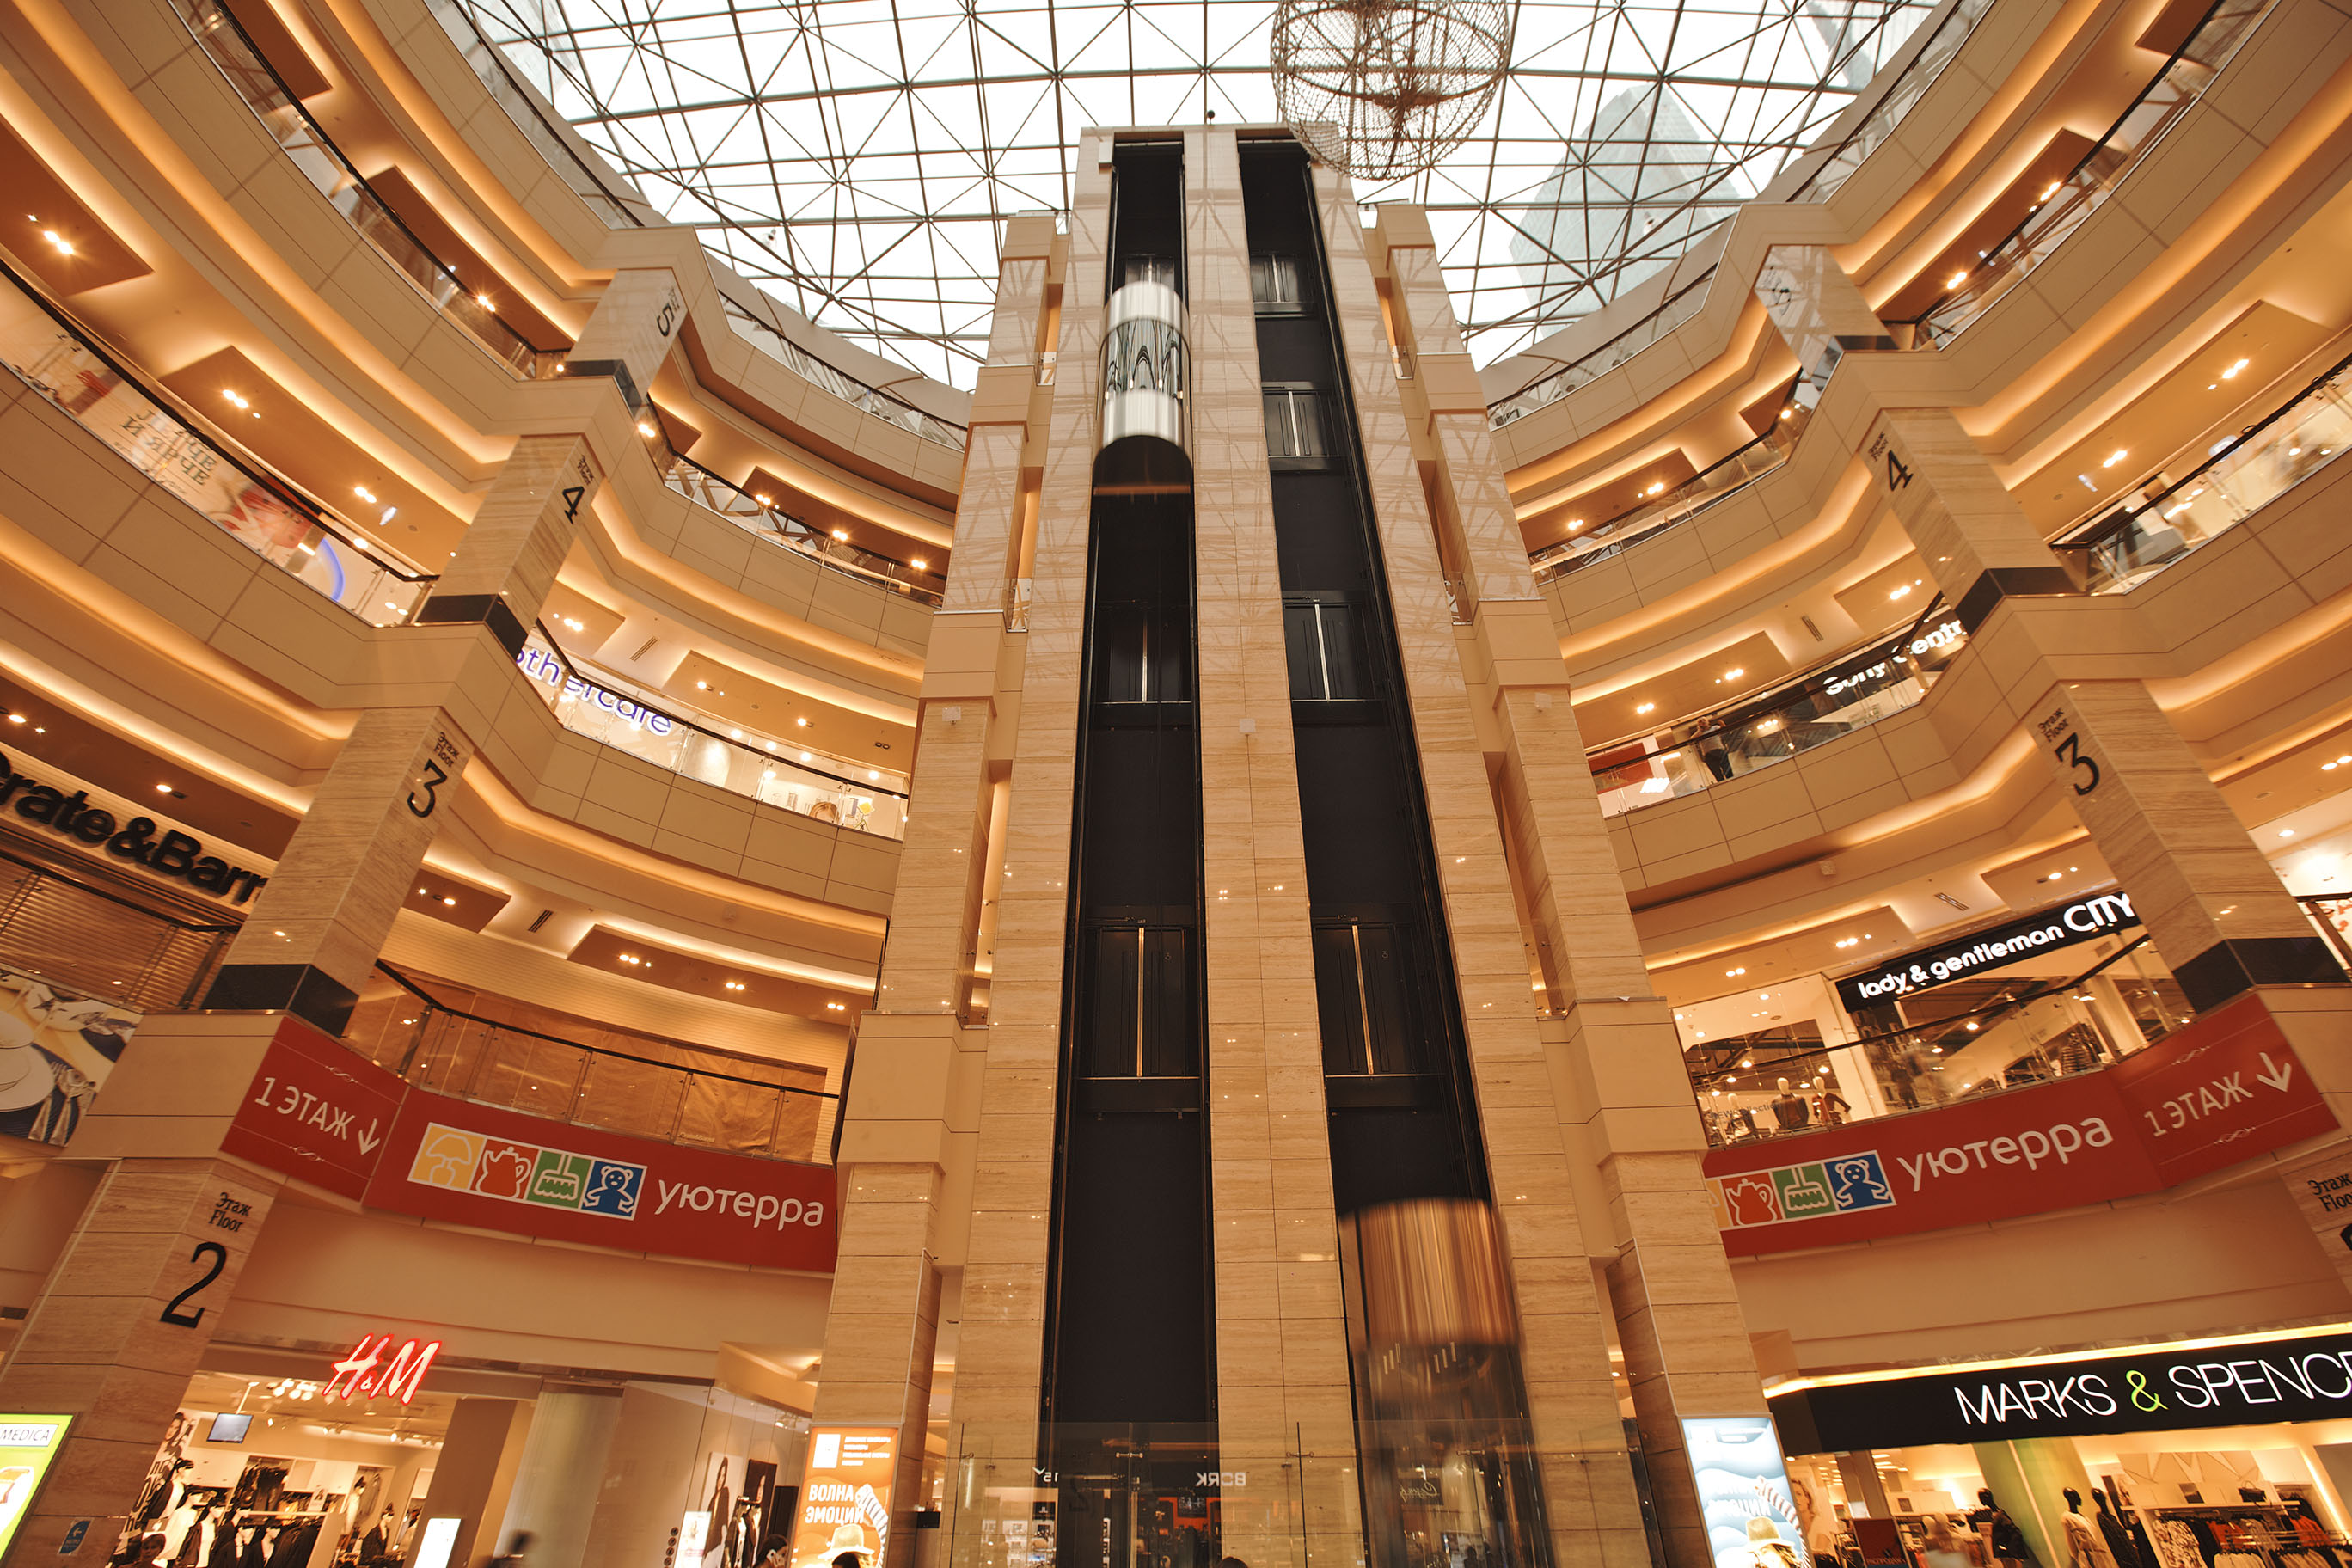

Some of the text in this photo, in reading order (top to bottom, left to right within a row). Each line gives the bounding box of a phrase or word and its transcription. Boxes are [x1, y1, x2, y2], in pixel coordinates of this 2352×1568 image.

[656, 303, 675, 337] 5
[1887, 450, 1914, 492] 4
[561, 486, 585, 525] 4
[2037, 707, 2064, 733] Этаж
[433, 742, 455, 768] Floor
[438, 732, 460, 759] Этаж
[2055, 732, 2100, 796] 3
[407, 758, 448, 818] 3
[0, 750, 270, 903] rate&Barr
[1858, 891, 2136, 999] lady & gentleman CITY
[254, 1077, 356, 1141] 1 ЭТАЖ
[2144, 1071, 2254, 1137] 1 ЭТАЖ
[1896, 1117, 2114, 1193] уютерра
[216, 1191, 253, 1216] Этаж
[654, 1179, 824, 1231] уютерра
[2307, 1173, 2352, 1196] Этаж
[2318, 1192, 2352, 1212] Floo
[208, 1209, 244, 1233] Floor
[159, 1241, 227, 1329] 2
[322, 1332, 443, 1406] H&M
[1953, 1374, 2118, 1425] MARKS
[2125, 1369, 2168, 1412] &
[808, 1484, 854, 1502] ВОЛНА
